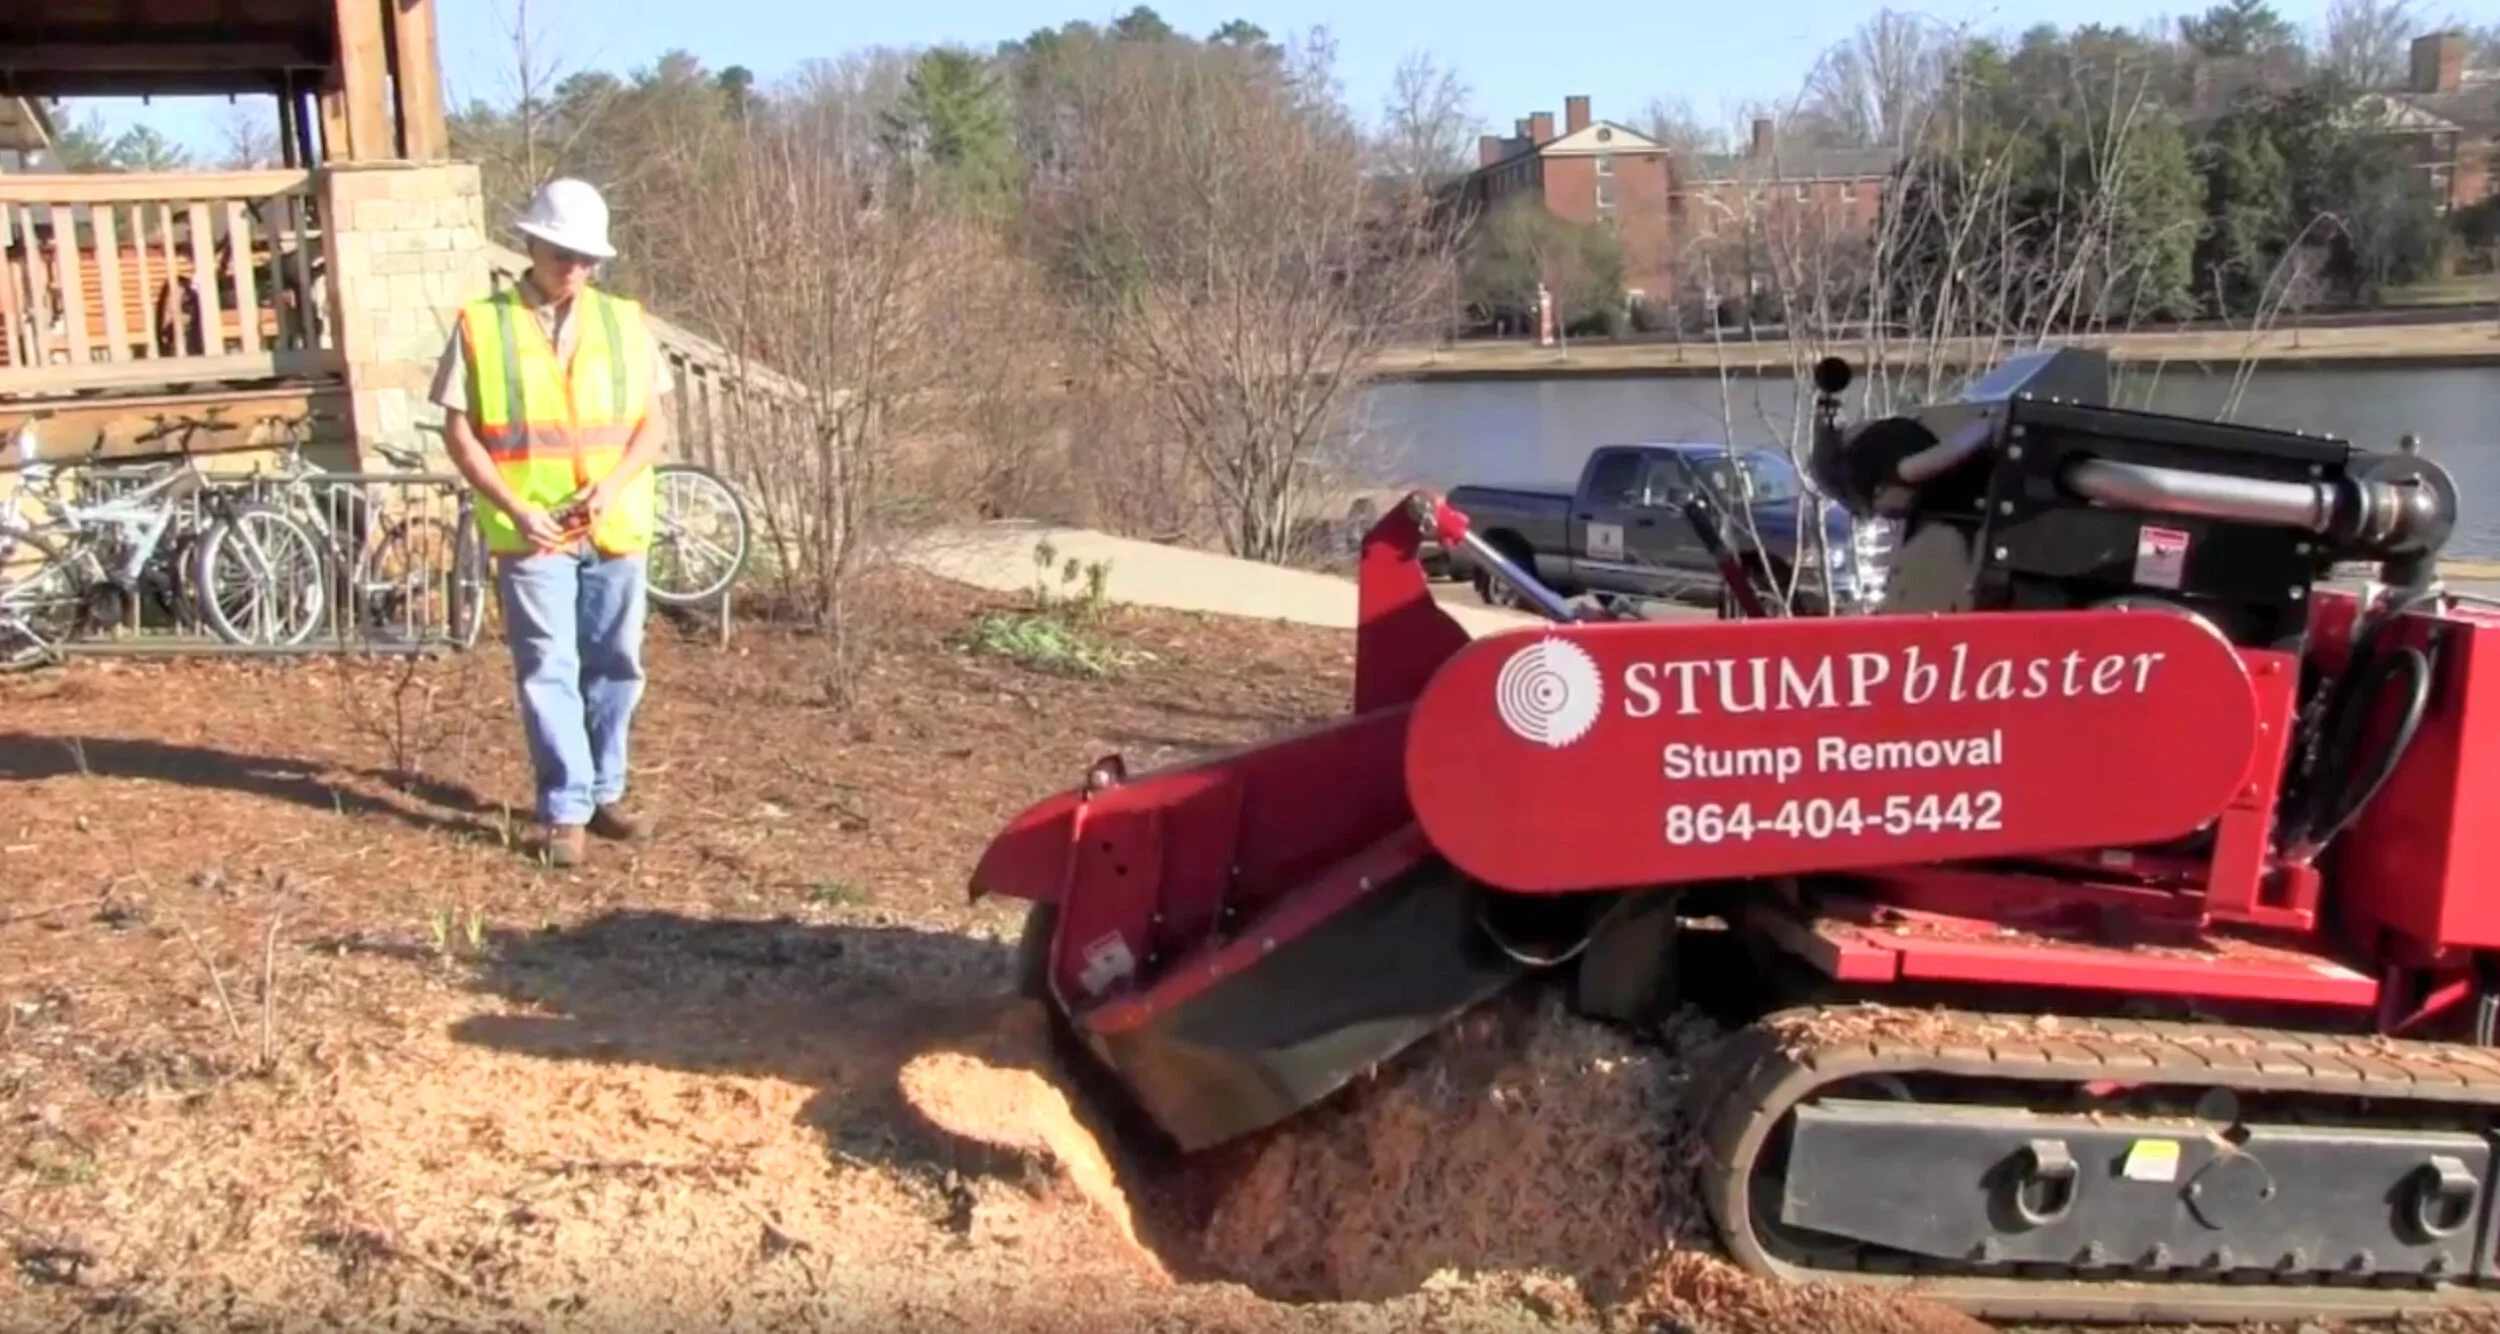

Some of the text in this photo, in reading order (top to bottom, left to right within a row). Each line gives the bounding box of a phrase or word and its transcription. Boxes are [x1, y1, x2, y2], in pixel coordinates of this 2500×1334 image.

[1663, 729, 2003, 783] Stump Removal
[1665, 789, 2003, 846] 864-404-5442
